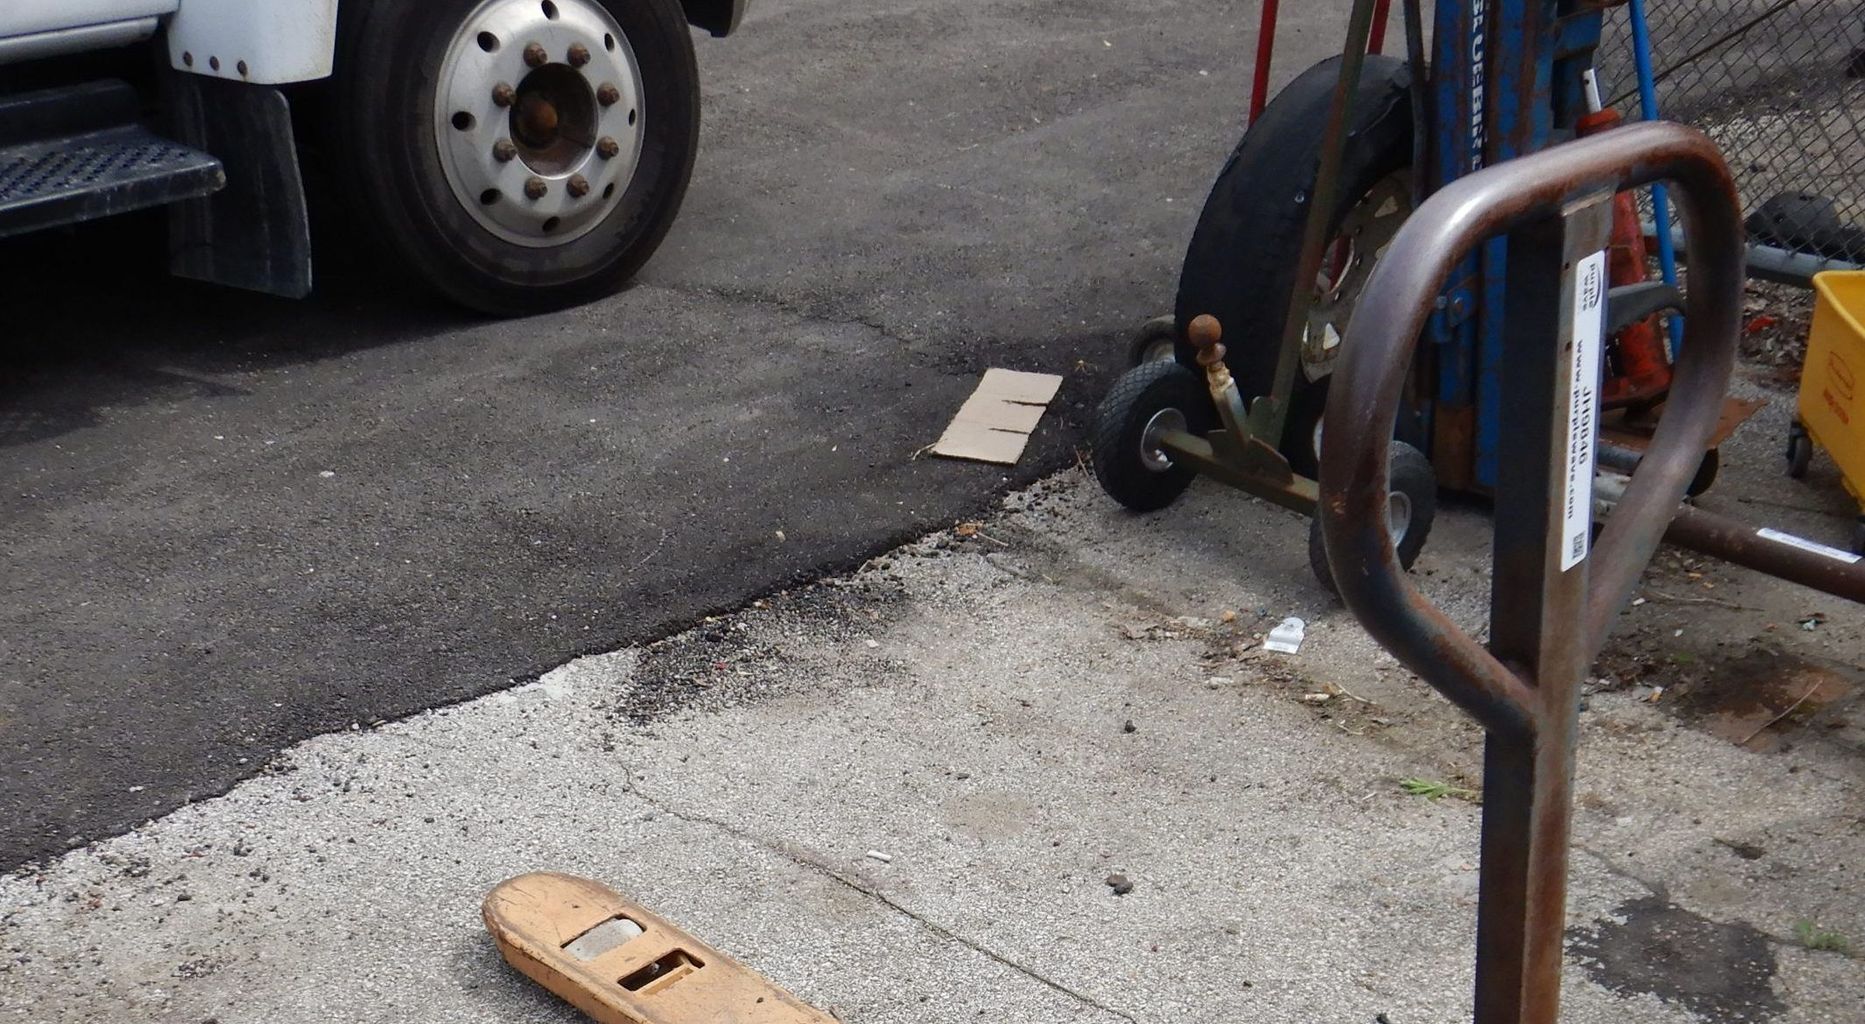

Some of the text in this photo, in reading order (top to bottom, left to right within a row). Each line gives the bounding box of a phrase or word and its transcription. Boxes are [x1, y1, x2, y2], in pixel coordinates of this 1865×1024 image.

[1588, 263, 1596, 308] purple
[1567, 340, 1583, 519] www.purplewave.com
[1579, 386, 1592, 465] JH9846
